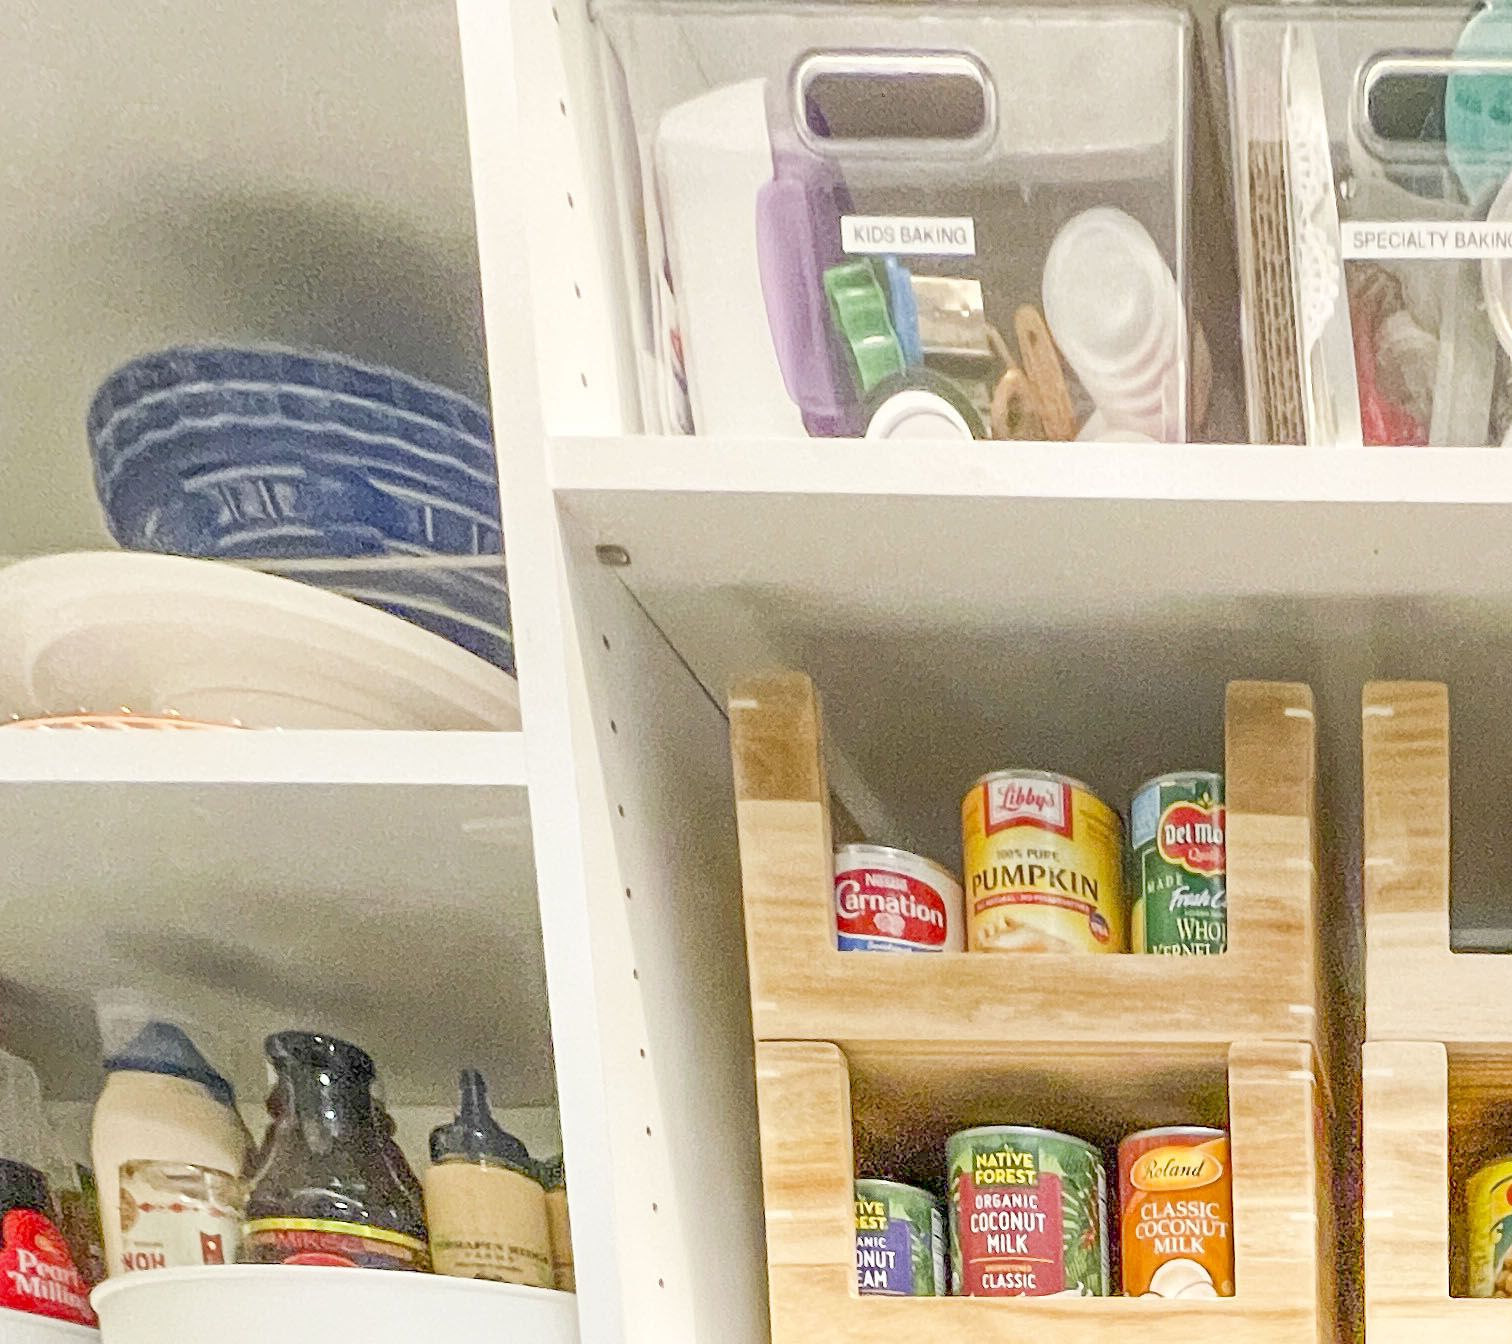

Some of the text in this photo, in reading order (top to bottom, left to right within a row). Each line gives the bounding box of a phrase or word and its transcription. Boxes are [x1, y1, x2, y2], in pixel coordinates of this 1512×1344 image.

[853, 226, 967, 247] KIDS BAKING
[1352, 230, 1448, 250] SPECIALTY
[997, 781, 1056, 812] Libby's
[1165, 825, 1192, 847] Del
[972, 863, 1099, 902] PUMPKIN
[836, 879, 944, 929] Carnation
[976, 1150, 1034, 1169] NATIVE
[1142, 1157, 1206, 1180] Roland
[975, 1167, 1037, 1186] FOREST
[974, 1193, 1039, 1211] ORGANIC
[1140, 1200, 1220, 1222] CLASSIC
[970, 1210, 1046, 1234] COCONUT
[1135, 1219, 1229, 1242] COCONUT
[986, 1232, 1029, 1254] MILK
[1153, 1236, 1205, 1256] MILK
[981, 1272, 1037, 1290] CLASSIC
